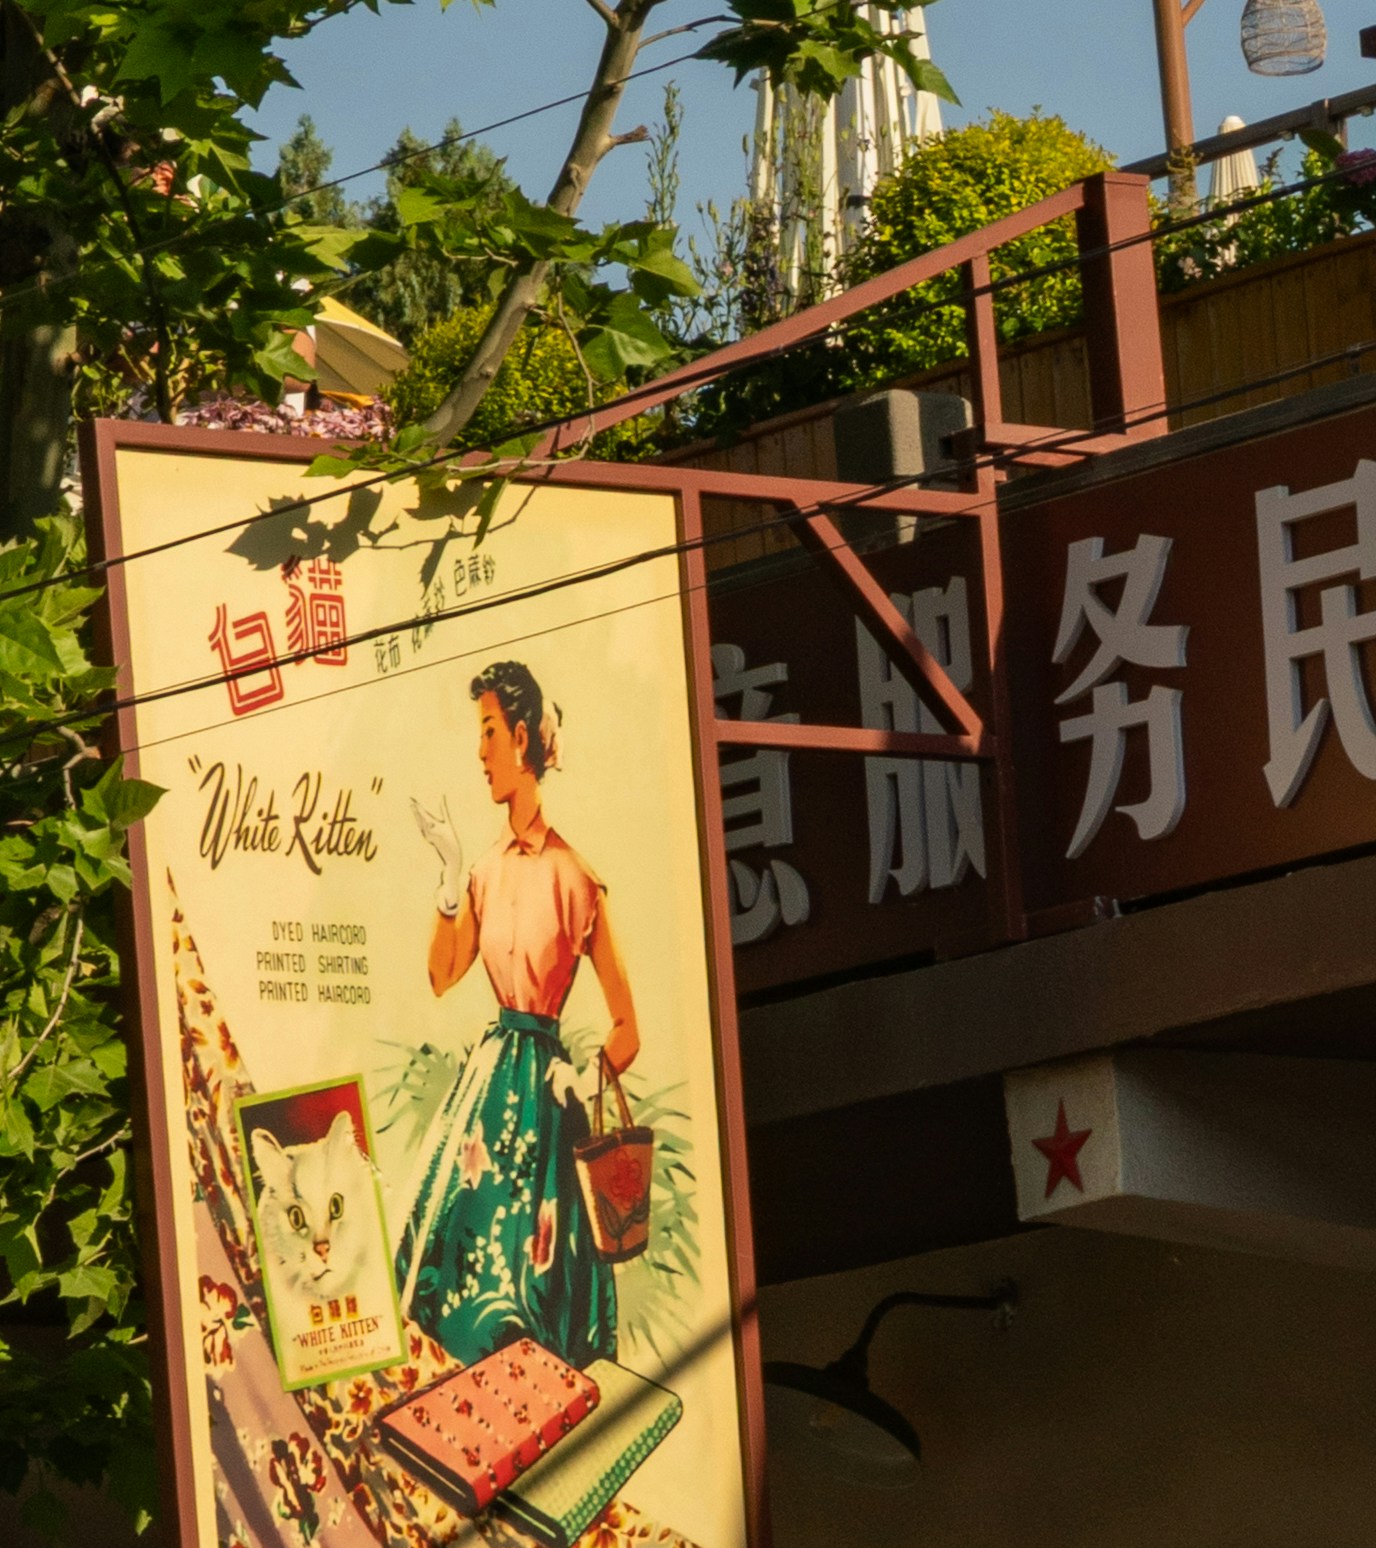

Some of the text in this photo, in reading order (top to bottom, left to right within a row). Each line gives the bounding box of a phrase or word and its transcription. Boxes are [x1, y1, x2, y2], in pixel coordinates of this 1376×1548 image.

[188, 754, 384, 876] "White Kitten"
[272, 920, 367, 946] DYED HAIRCORD
[256, 951, 369, 977] PRINTED SHIRTING
[259, 980, 371, 1005] PRINTED HAIRCORD
